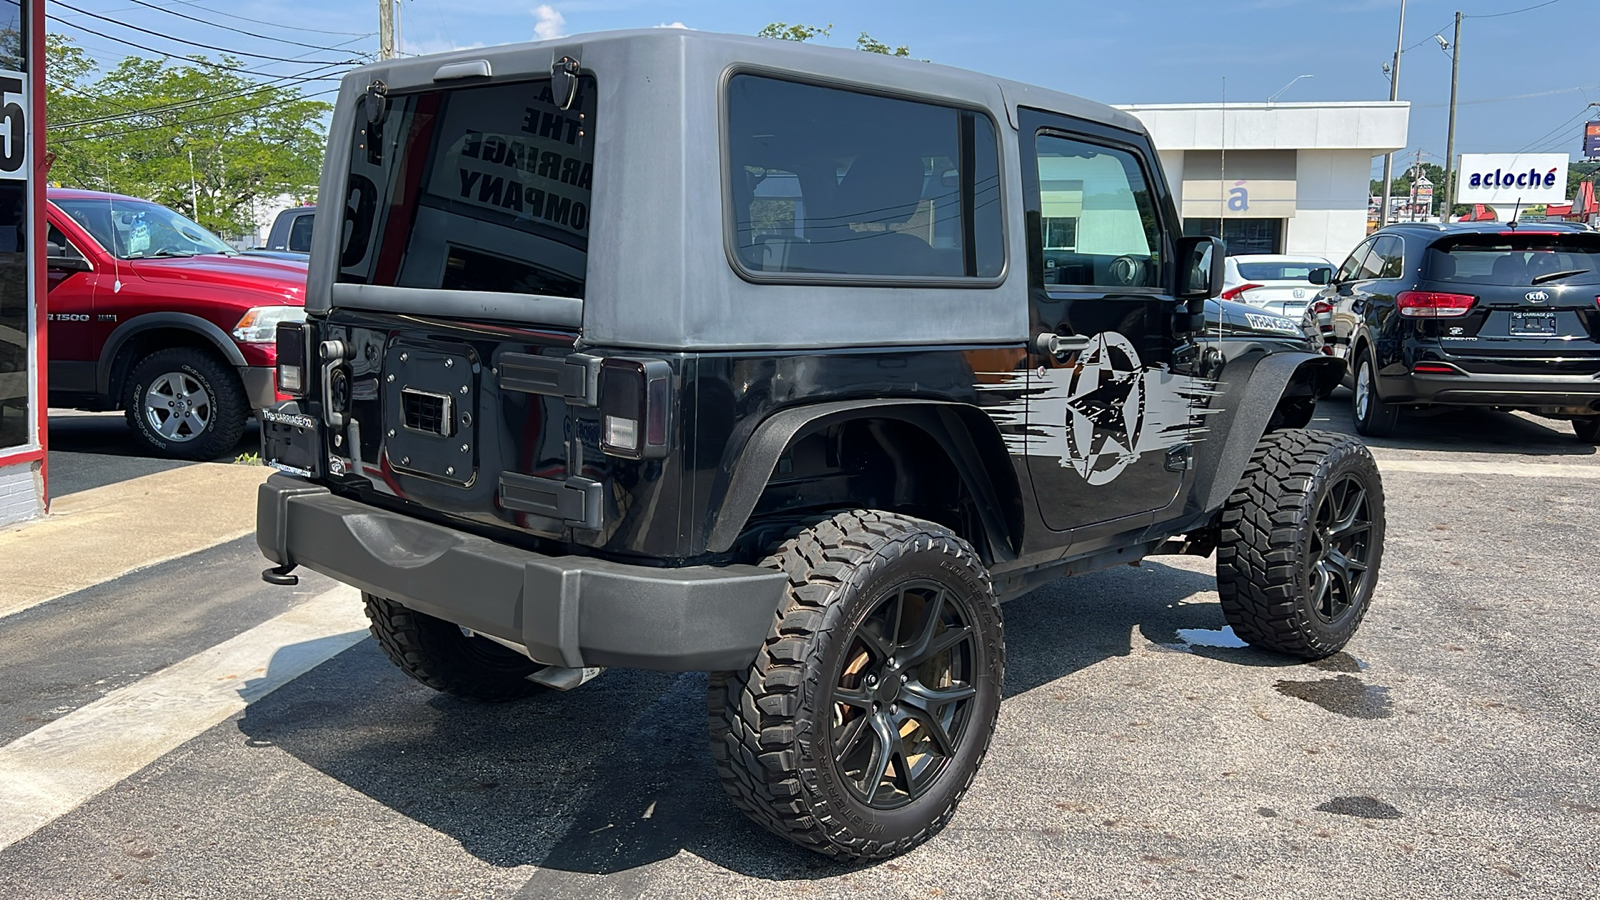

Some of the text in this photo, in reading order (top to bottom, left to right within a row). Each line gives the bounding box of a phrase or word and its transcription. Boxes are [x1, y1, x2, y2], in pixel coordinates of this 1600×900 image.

[1469, 167, 1557, 187] acloché
[1526, 291, 1547, 301] KIA
[56, 313, 90, 322] 1500
[276, 413, 303, 426] CARRIAGE
